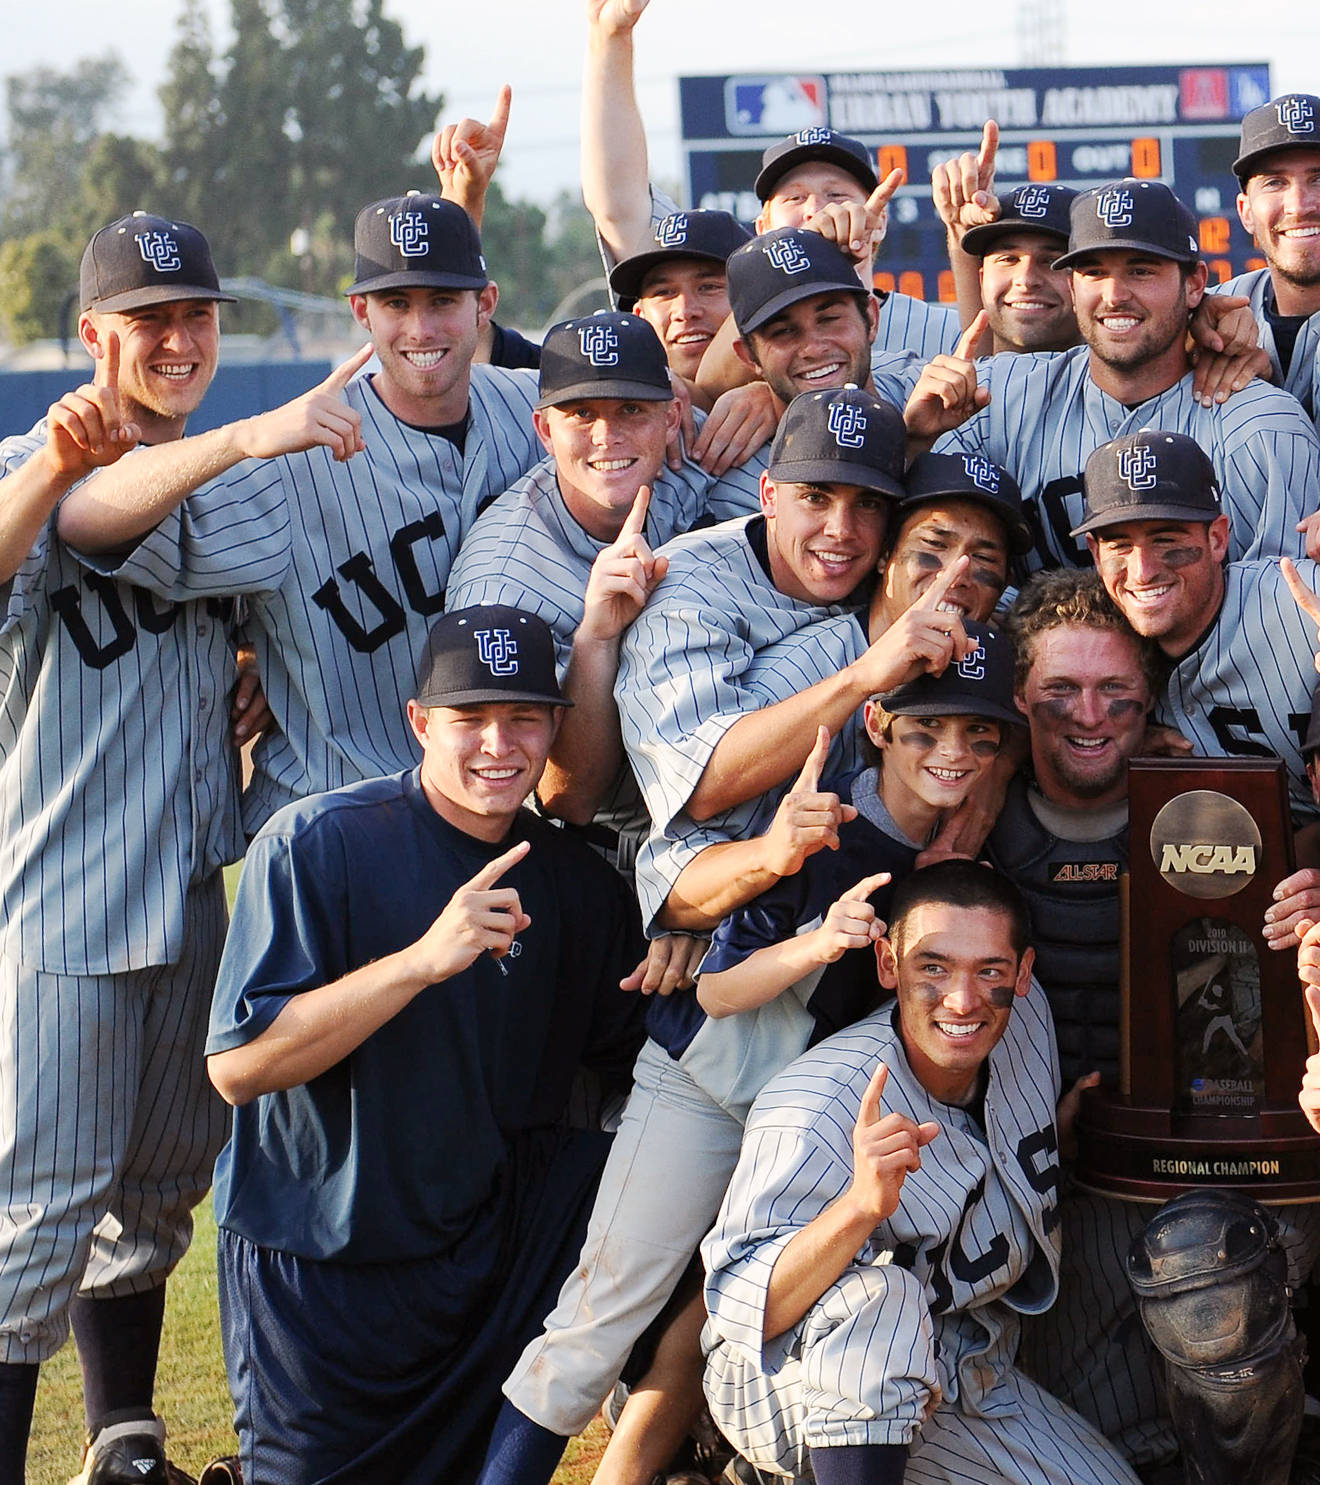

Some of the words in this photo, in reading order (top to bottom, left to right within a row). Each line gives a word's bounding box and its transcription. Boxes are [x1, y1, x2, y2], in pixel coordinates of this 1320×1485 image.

[1276, 99, 1314, 134] UC
[1014, 186, 1051, 217] UC
[1096, 190, 1134, 228] UC
[388, 211, 430, 257] UC
[656, 211, 688, 247] UC
[135, 231, 182, 272] UC
[763, 237, 811, 276] UC
[578, 325, 619, 366] UC
[827, 402, 867, 449] UC
[961, 454, 1001, 495] UC
[1117, 444, 1157, 491] UC
[474, 628, 519, 677] UC
[1053, 863, 1118, 881] ALL-STAR
[1159, 843, 1257, 876] NCAA
[1188, 939, 1237, 954] DIVISION
[1192, 1094, 1256, 1107] CHAMPIONSHIP
[1152, 1157, 1213, 1176] REGIONAL
[1213, 1159, 1281, 1177] CHAMPION
